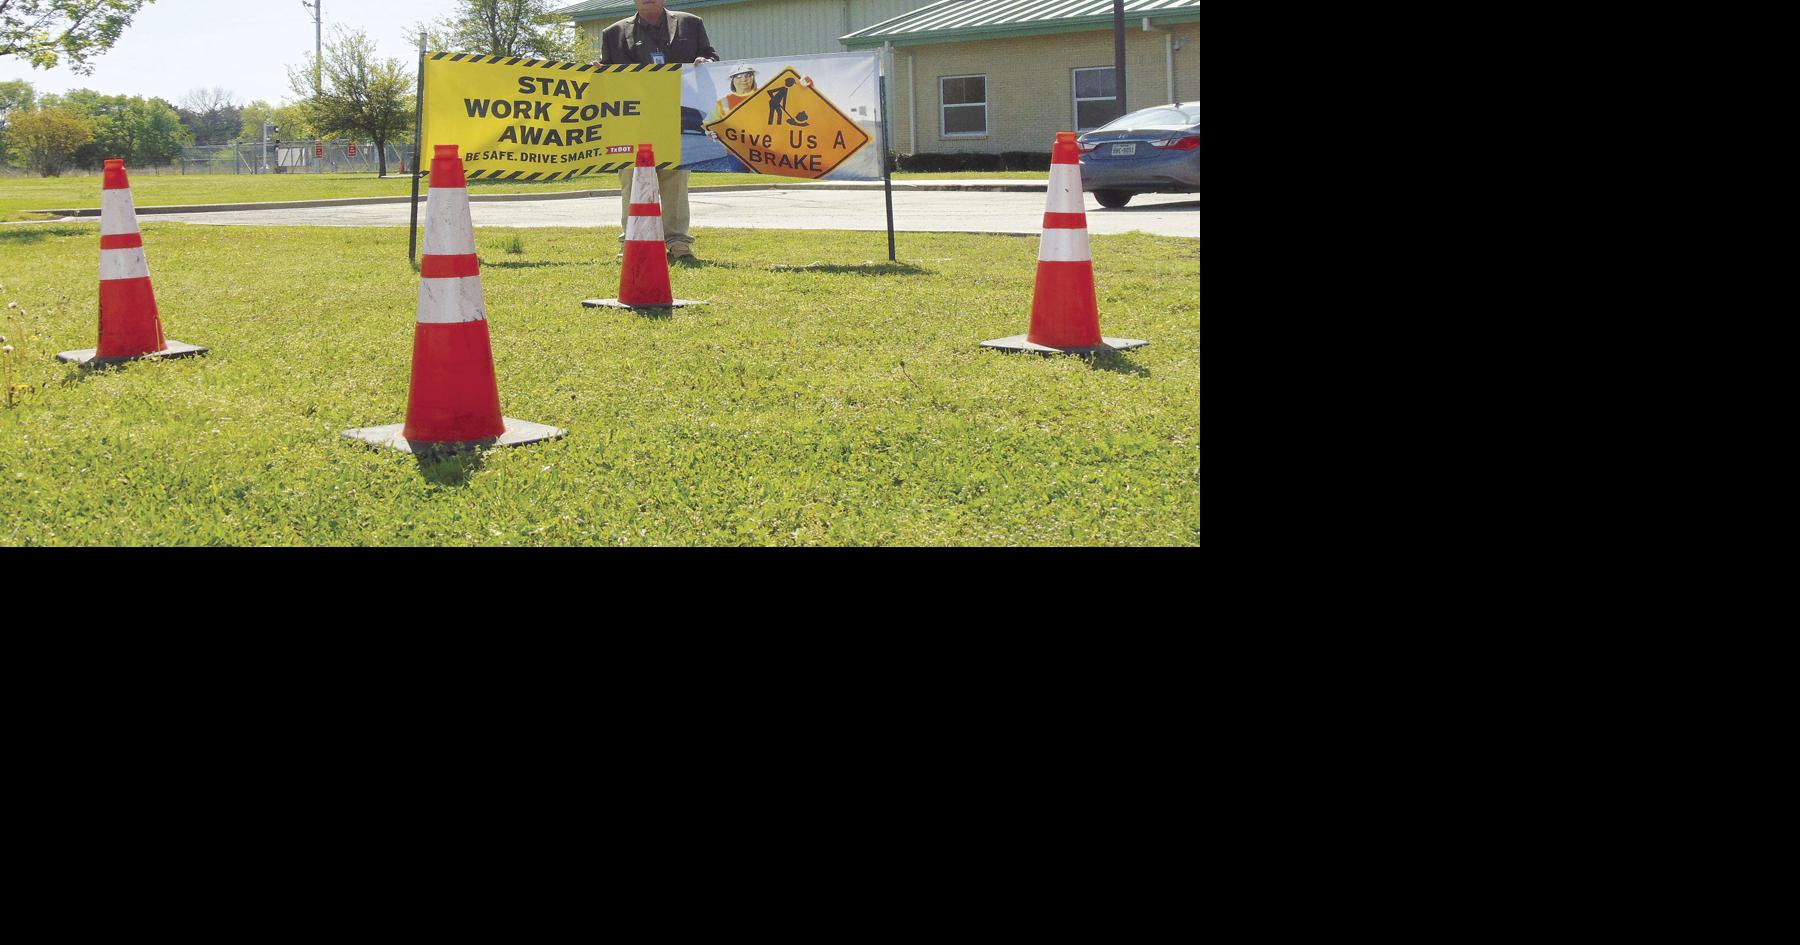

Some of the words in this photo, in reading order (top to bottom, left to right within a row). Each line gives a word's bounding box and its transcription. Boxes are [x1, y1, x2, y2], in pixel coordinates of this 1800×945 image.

[518, 76, 590, 100] STAY
[464, 98, 551, 122] WORK
[560, 100, 641, 123] ZONE
[498, 124, 603, 147] AWARE
[724, 127, 772, 148] Give
[789, 130, 818, 149] Us
[832, 130, 847, 150] A
[465, 152, 481, 162] BE
[482, 150, 518, 161] SAFE.
[520, 152, 558, 164] DRIVE
[560, 147, 603, 164] SMART.
[749, 148, 823, 173] BRAKE
